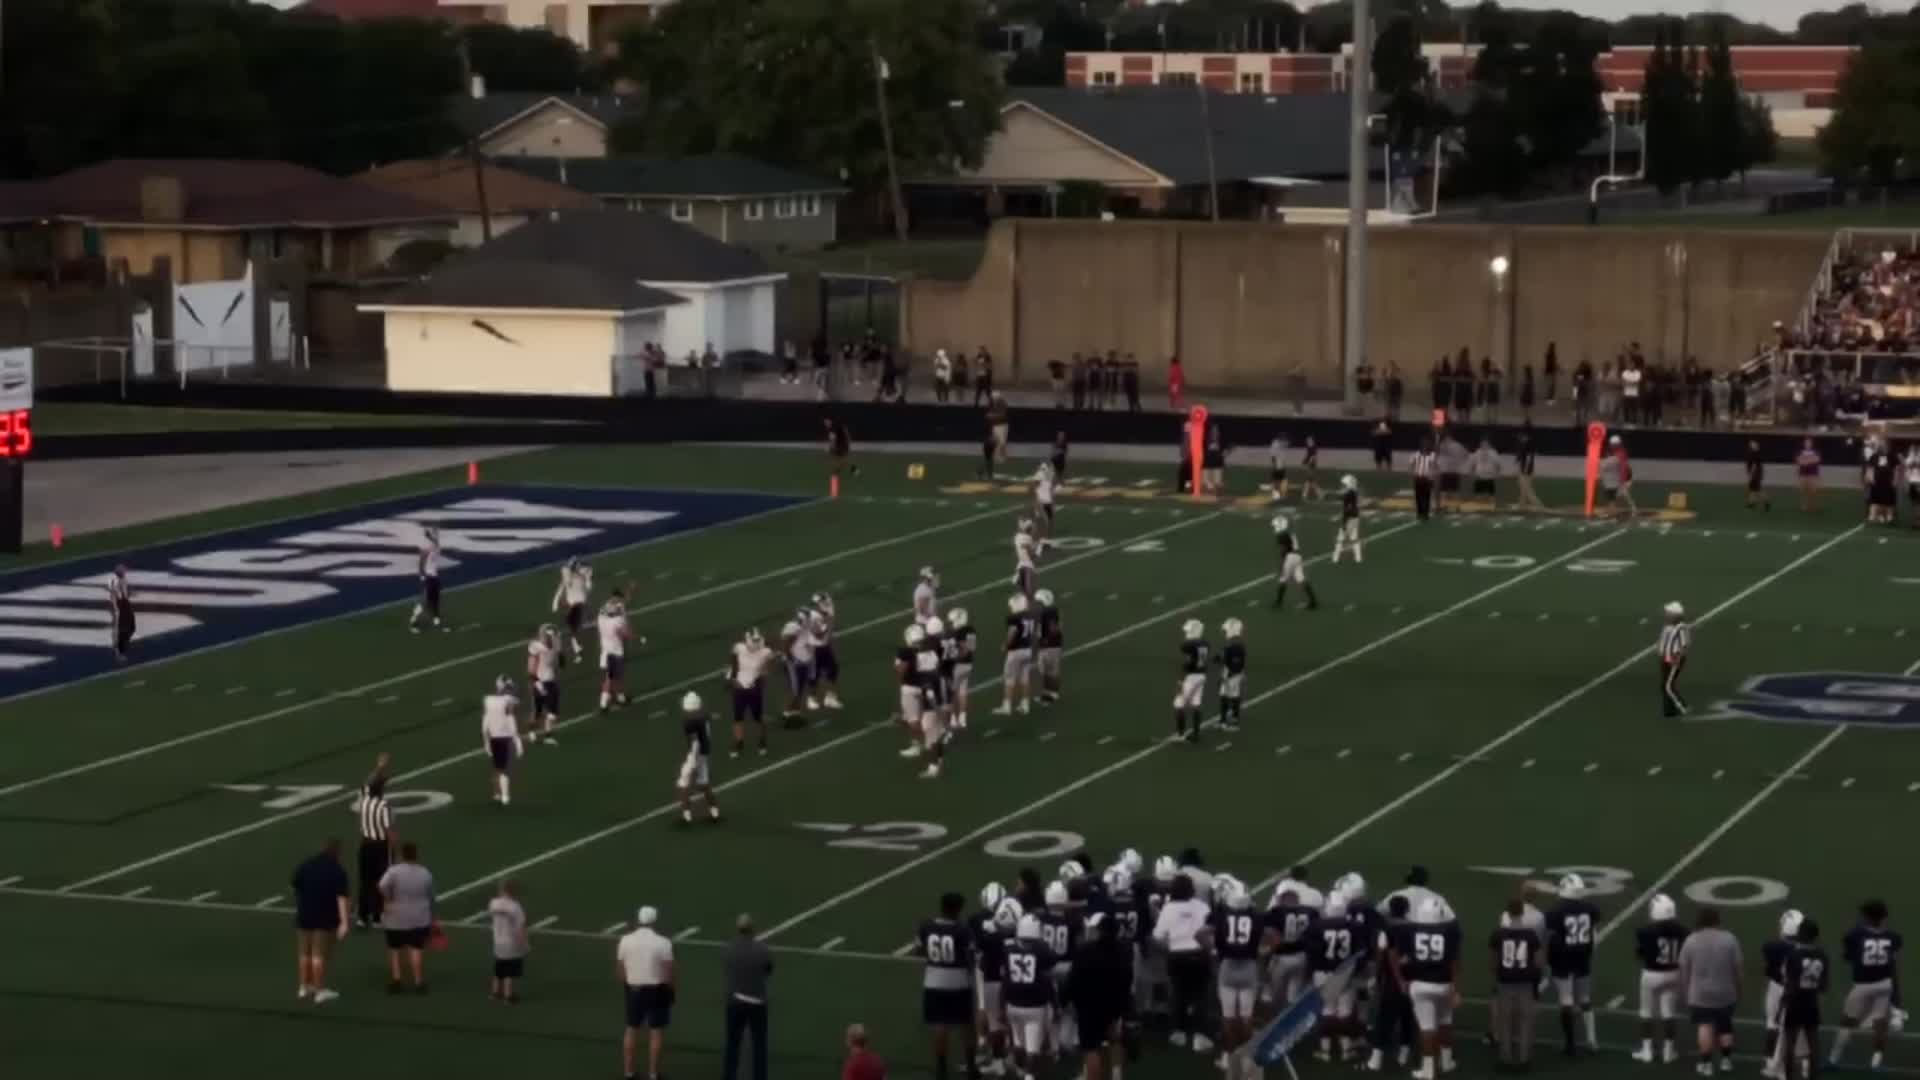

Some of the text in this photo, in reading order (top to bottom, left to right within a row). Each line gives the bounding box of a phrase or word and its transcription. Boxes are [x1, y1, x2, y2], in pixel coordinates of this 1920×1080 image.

[1225, 914, 1253, 945] 19
[1322, 928, 1353, 961] 73
[927, 933, 956, 964] 60
[1414, 932, 1446, 962] 59
[1861, 938, 1893, 968] 25
[1008, 952, 1037, 985] 53
